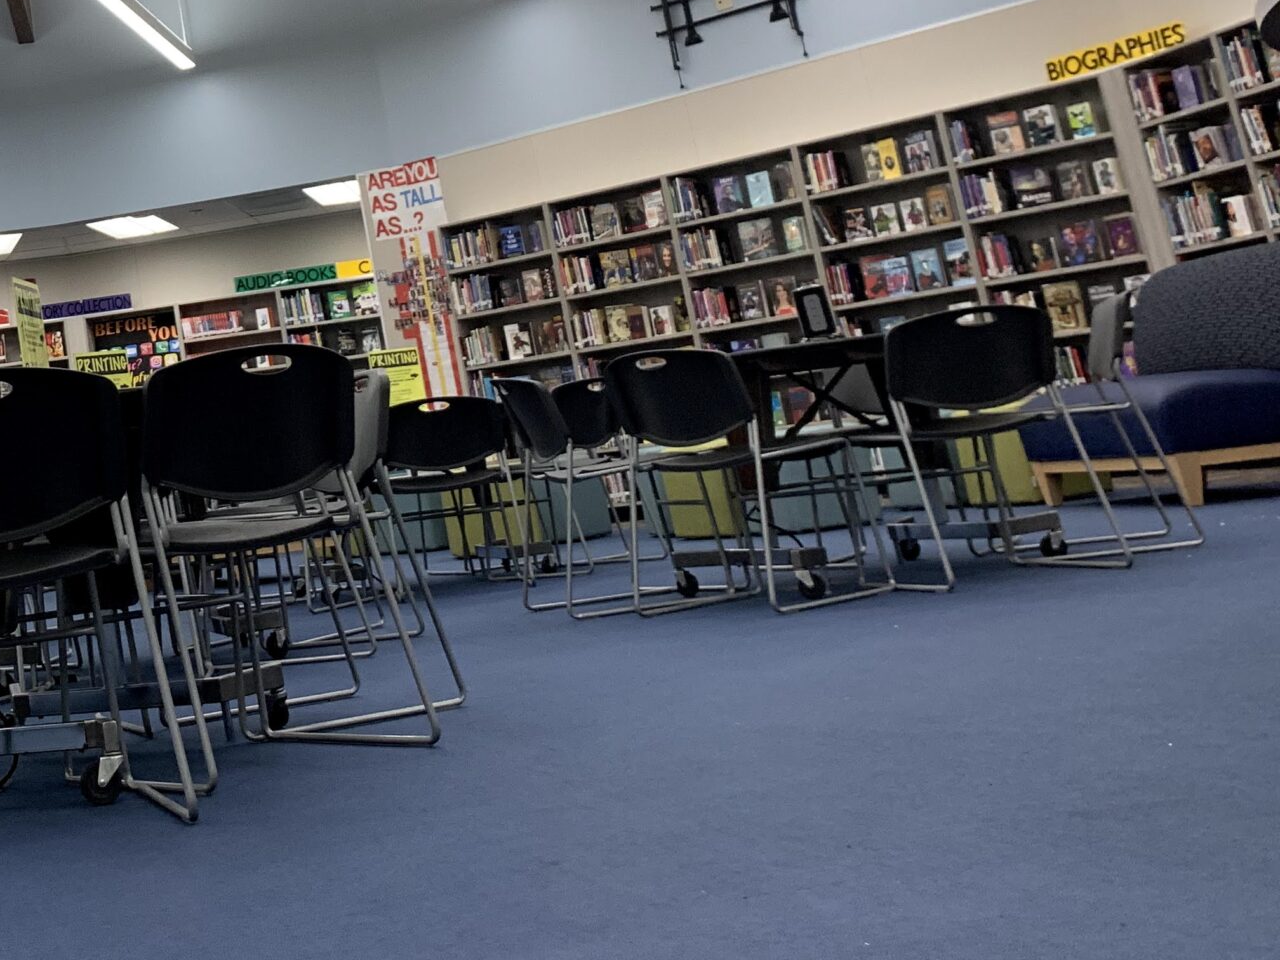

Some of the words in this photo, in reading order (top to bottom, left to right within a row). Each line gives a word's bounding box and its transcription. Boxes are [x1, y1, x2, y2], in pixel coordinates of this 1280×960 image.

[1046, 23, 1186, 81] BIOGRAPHIES
[368, 168, 406, 191] ARE
[404, 158, 438, 185] YOU
[372, 193, 397, 214] AS
[400, 184, 443, 208] TALL
[67, 297, 131, 317] COLLECTION
[95, 316, 157, 337] BEFORE
[77, 354, 127, 373] PRINTING
[371, 352, 417, 366] PRINTING
